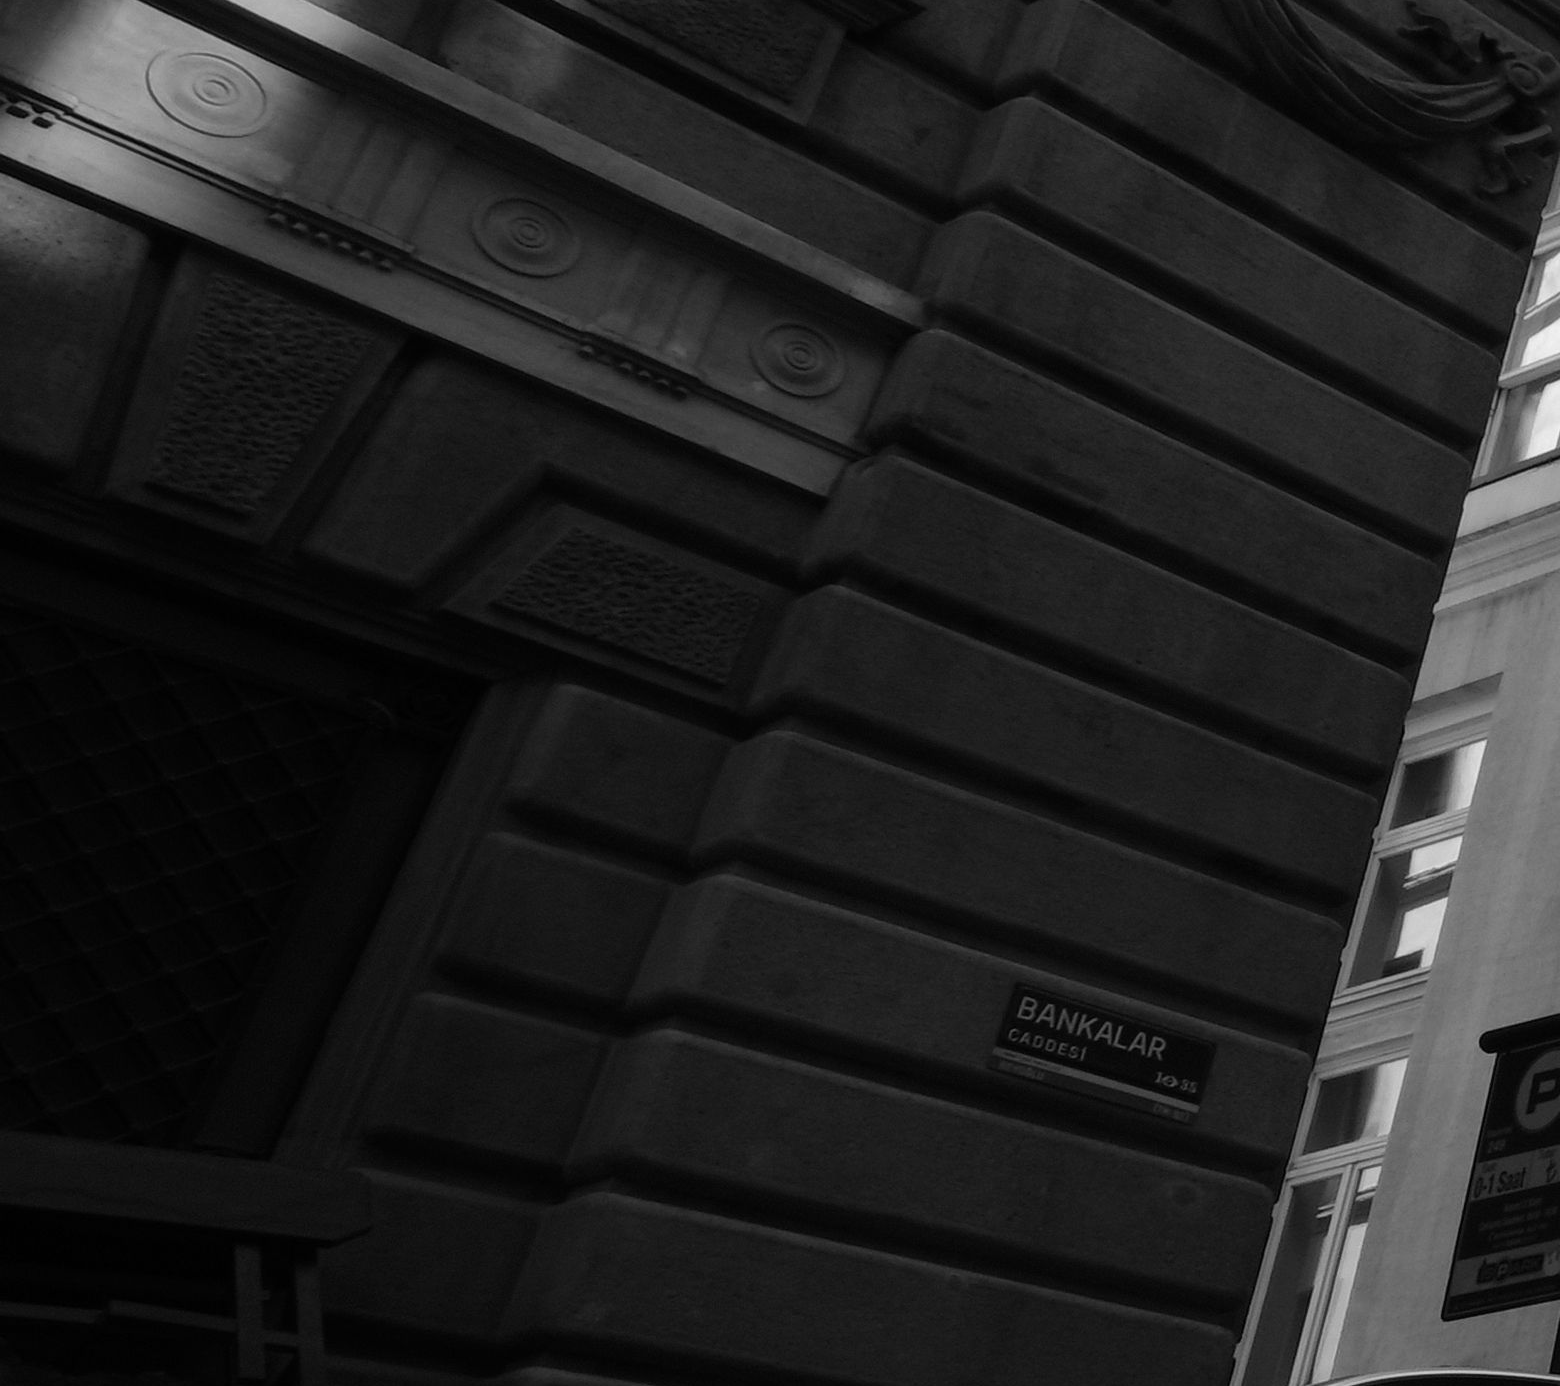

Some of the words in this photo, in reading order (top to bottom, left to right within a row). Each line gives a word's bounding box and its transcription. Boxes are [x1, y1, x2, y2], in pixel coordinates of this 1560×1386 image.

[1007, 1027, 1088, 1062] CADDESİ
[1016, 995, 1167, 1062] BANKALAR
[1473, 1174, 1495, 1199] 0-1
[1497, 1167, 1527, 1193] Saat
